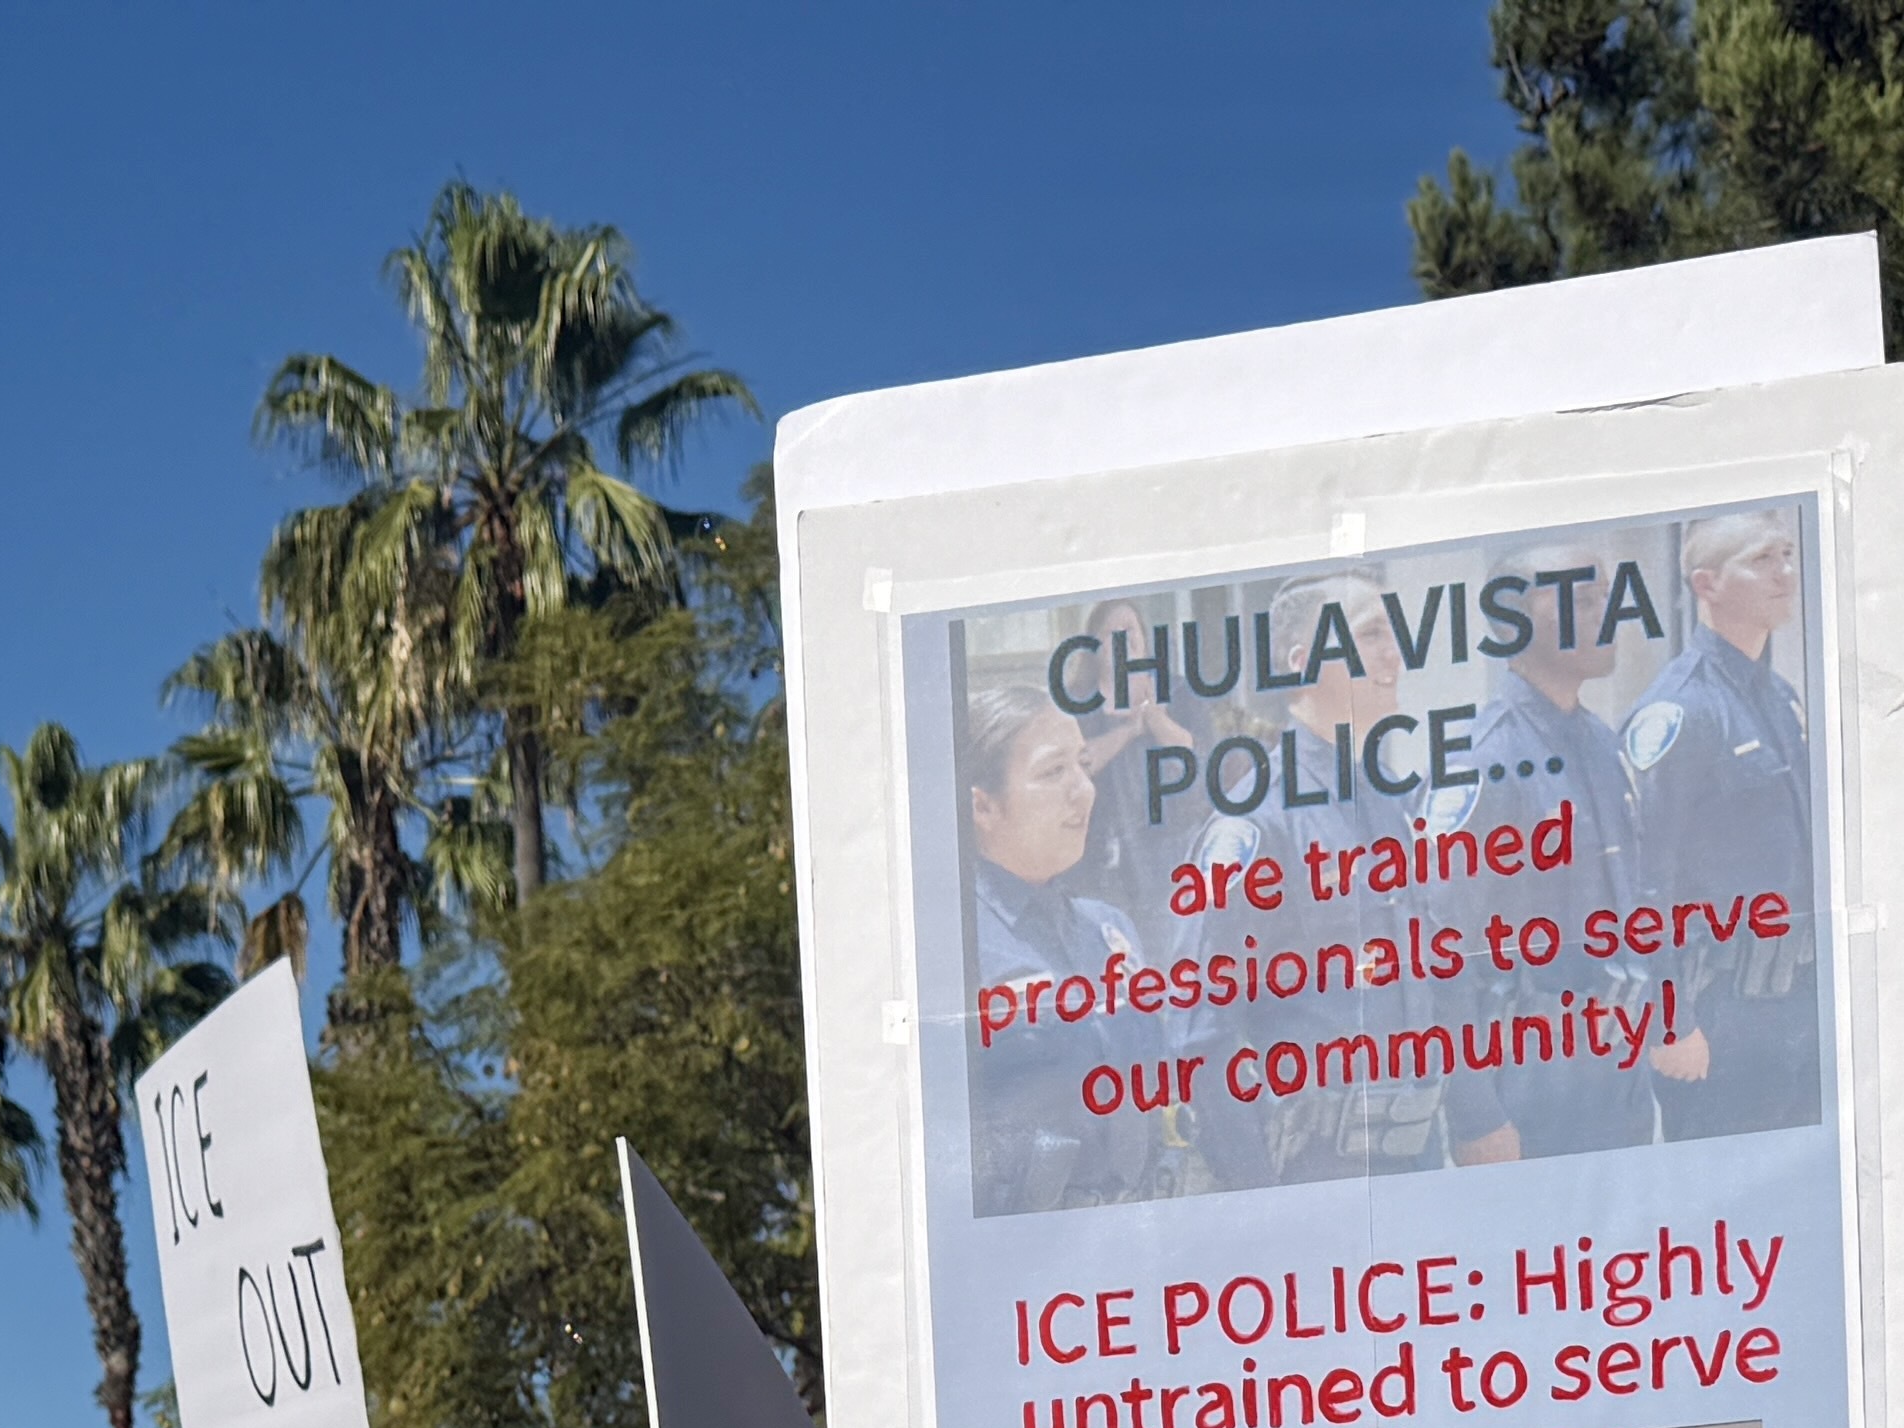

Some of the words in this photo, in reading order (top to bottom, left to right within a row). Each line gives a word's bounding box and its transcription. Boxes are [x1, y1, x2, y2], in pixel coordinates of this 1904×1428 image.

[1049, 600, 1365, 716] CHULA
[1384, 561, 1664, 672] VISTA
[1147, 705, 1565, 824] POLICE...
[1169, 854, 1284, 916] are
[1305, 800, 1574, 901] trained
[979, 921, 1464, 1045] professionals
[1484, 915, 1560, 972] to
[1584, 889, 1789, 953] serve
[1082, 1050, 1206, 1115] our
[1226, 979, 1677, 1101] community!
[154, 1069, 222, 1246] ICE
[237, 1237, 341, 1408] OUT
[1016, 1291, 1134, 1366] ICE
[1164, 1258, 1485, 1354] POLICE:
[1516, 1221, 1783, 1325] Highly
[1443, 1342, 1525, 1411] to
[1552, 1328, 1780, 1400] serve
